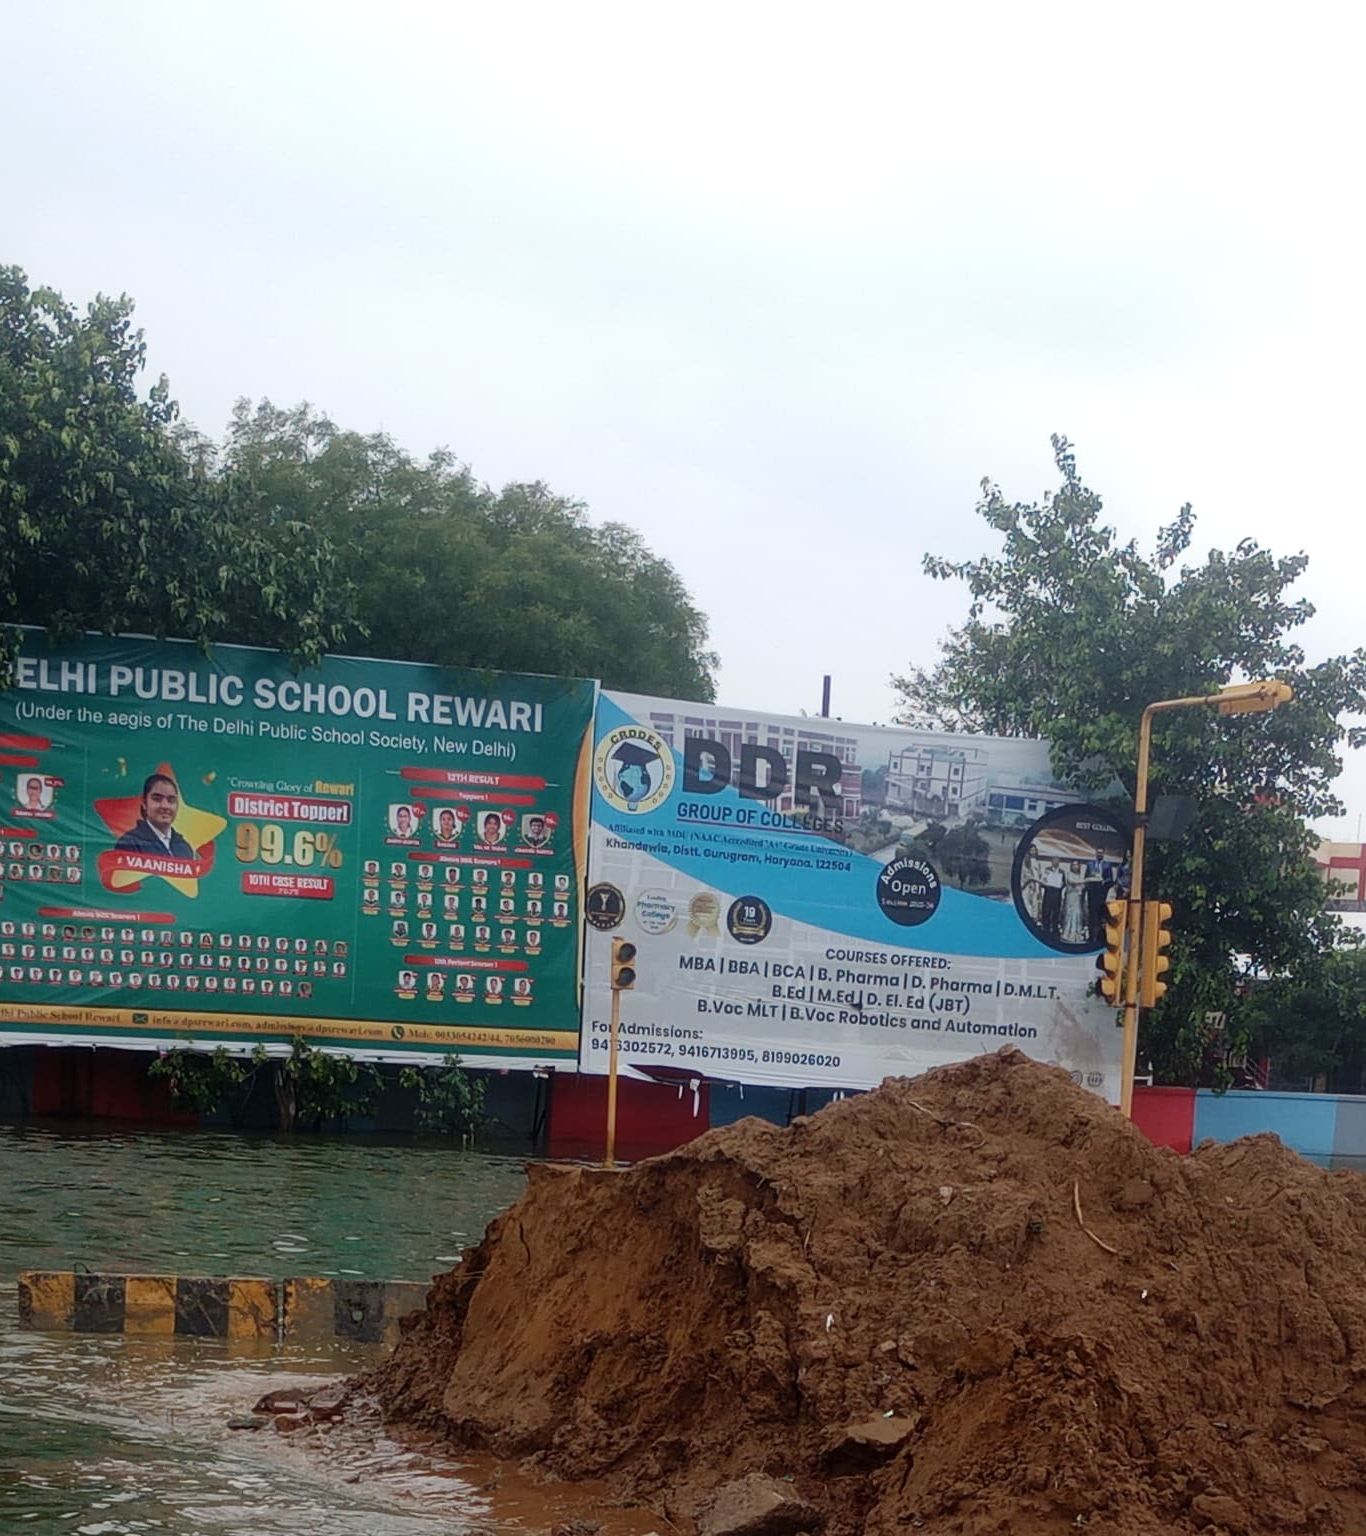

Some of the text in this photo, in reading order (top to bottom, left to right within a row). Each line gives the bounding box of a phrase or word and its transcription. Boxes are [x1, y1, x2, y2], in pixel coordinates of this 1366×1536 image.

[13, 656, 543, 733] ELHI PUBLIC SCHOOL REWARI
[15, 701, 516, 762] (Under the aegis of The Delhi Public School Society, New Delhi)
[682, 736, 844, 811] DDR
[234, 796, 290, 818] District
[677, 802, 844, 834] GROUP OF COLLEGES
[235, 822, 343, 869] 99.6%
[126, 855, 193, 876] VAANISHA
[880, 857, 937, 889] Admissions
[297, 877, 329, 890] RESULT
[891, 880, 926, 896] Open
[679, 955, 716, 972] MBA
[728, 959, 760, 976] BBA
[772, 963, 805, 979] BCA
[818, 967, 832, 982] B.
[836, 969, 900, 987] Pharma
[911, 975, 926, 989] D.
[930, 976, 992, 995] Pharma
[825, 948, 952, 970] COURSES OFFERED:
[772, 984, 806, 1000] B.Ed
[817, 988, 854, 1005] M.Ed
[867, 992, 881, 1007] D.
[906, 995, 924, 1009] Ed
[928, 993, 971, 1016] (JBT)
[618, 1022, 703, 1040] Admissions:
[697, 999, 1038, 1039] B.Voc MLT B.Voc Robotics and Automation
